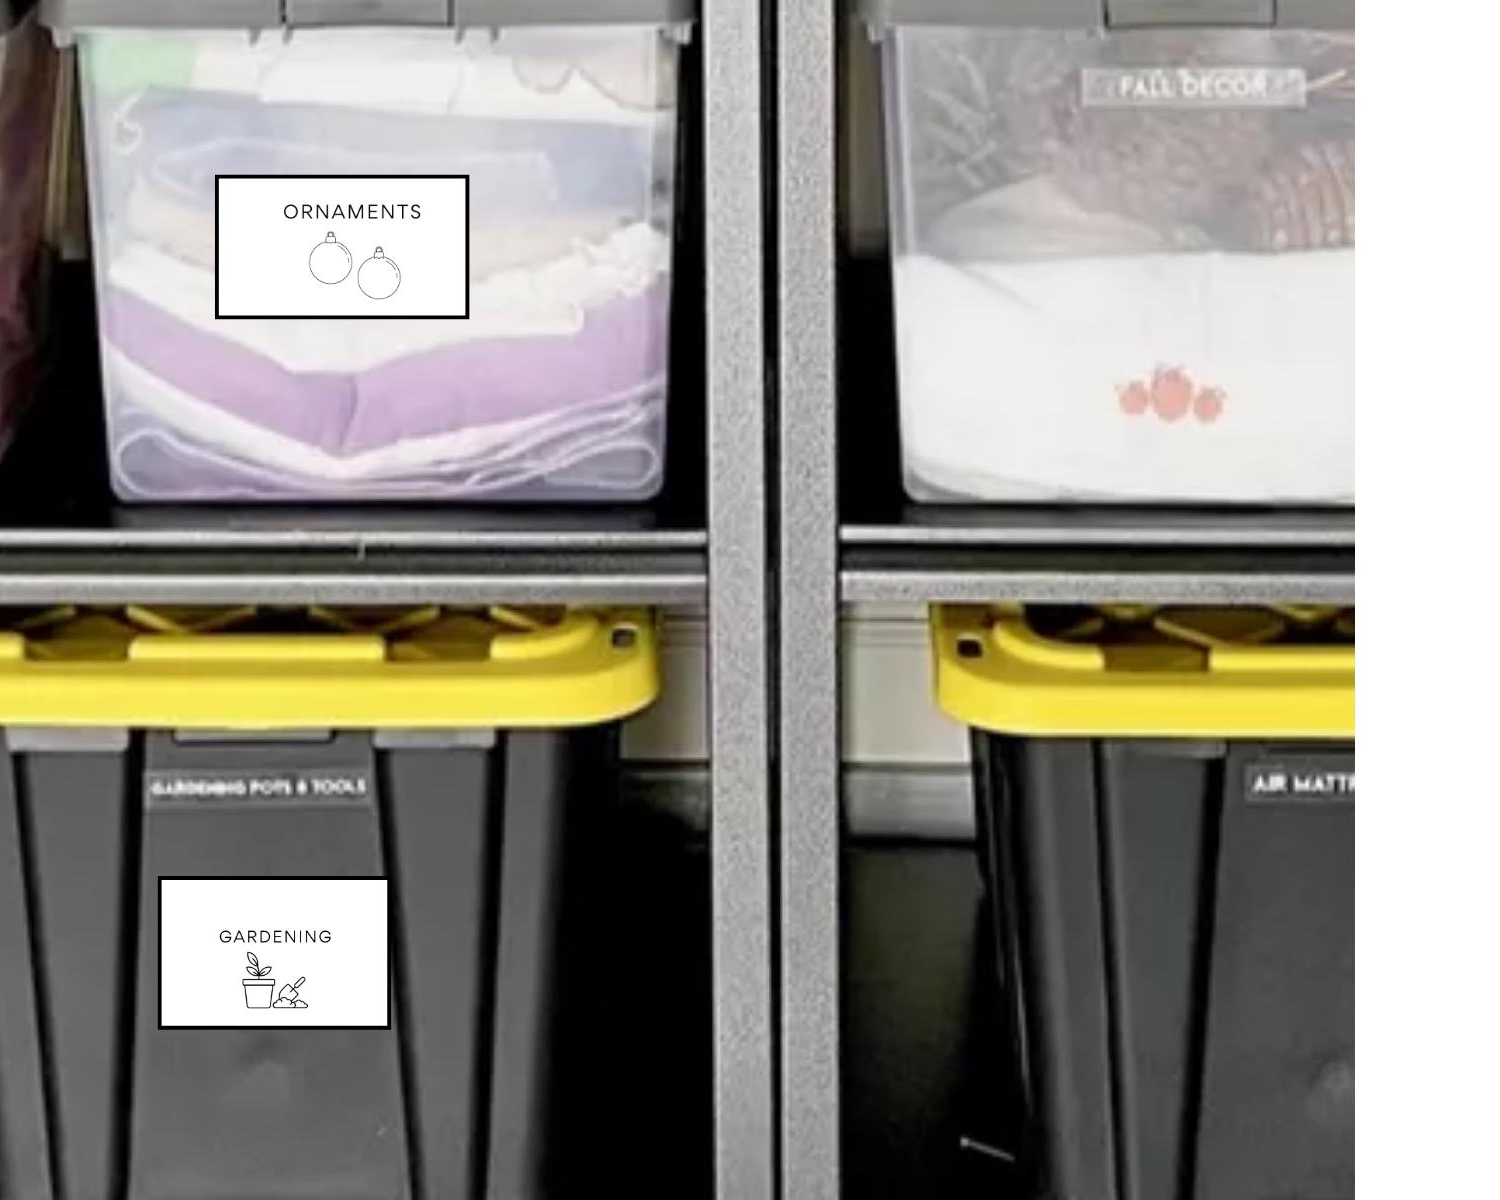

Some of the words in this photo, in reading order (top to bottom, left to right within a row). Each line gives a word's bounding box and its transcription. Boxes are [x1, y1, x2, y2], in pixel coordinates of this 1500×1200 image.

[1119, 73, 1174, 97] FALL
[1180, 72, 1268, 97] DECOR
[249, 778, 293, 796] POTS
[311, 778, 366, 795] TOOLS
[1252, 773, 1287, 793] AIR
